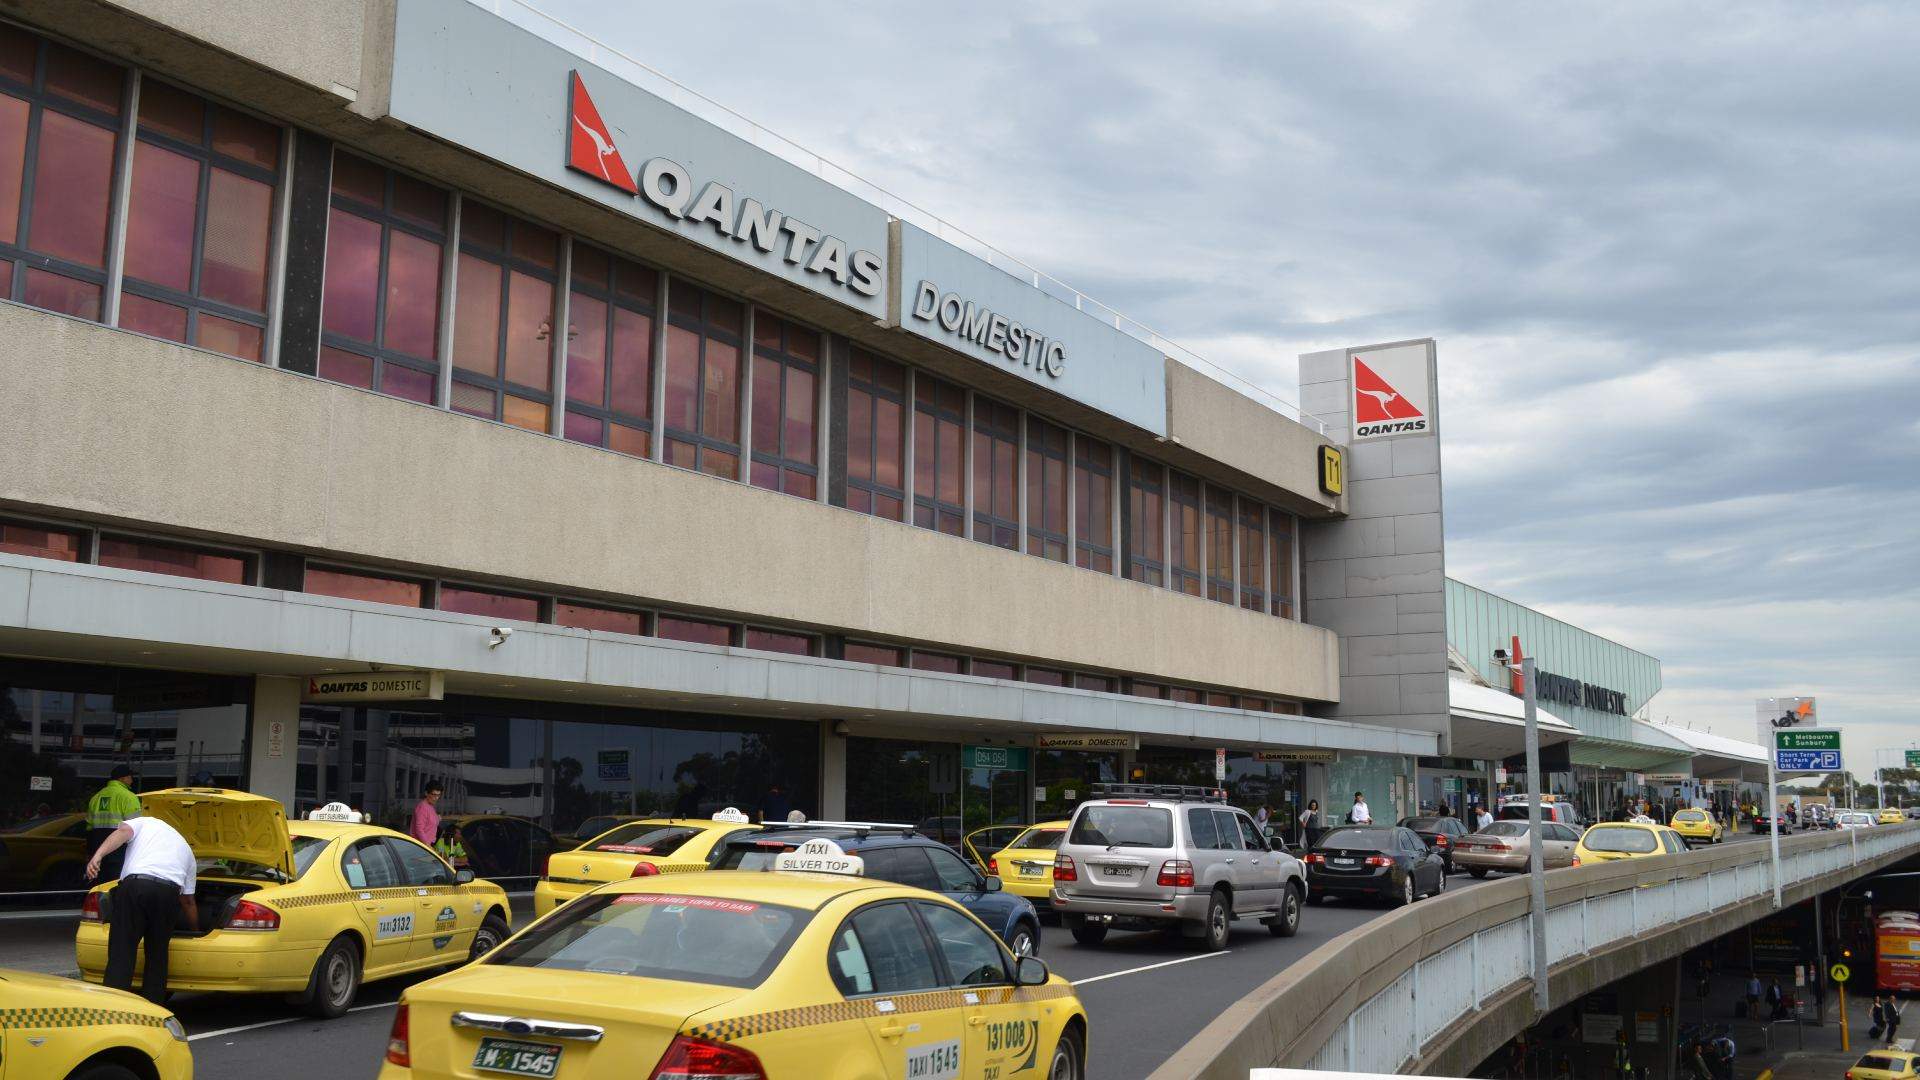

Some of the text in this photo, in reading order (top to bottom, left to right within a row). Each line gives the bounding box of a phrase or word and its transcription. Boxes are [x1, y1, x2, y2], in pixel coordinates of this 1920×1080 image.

[637, 156, 883, 297] QANTAS
[912, 279, 1067, 378] DOMESTIC
[1357, 420, 1426, 437] QANTAS
[1327, 456, 1340, 485] T1
[320, 680, 422, 694] QANTAS DOMESTIC
[1535, 667, 1627, 716] ANTAS DOMESTIC
[1088, 738, 1128, 746] DOMESTIC
[1824, 754, 1835, 766] P
[328, 804, 342, 812] TAXI
[805, 843, 829, 855] TAXI
[783, 860, 849, 871] SILVER TOP
[380, 916, 411, 933] TAXI 3132
[987, 1020, 1025, 1051] 131 008
[482, 1048, 500, 1066] M
[510, 1051, 557, 1074] 1545
[908, 1044, 958, 1078] TAXI 1545
[984, 1066, 1000, 1080] TAXI
